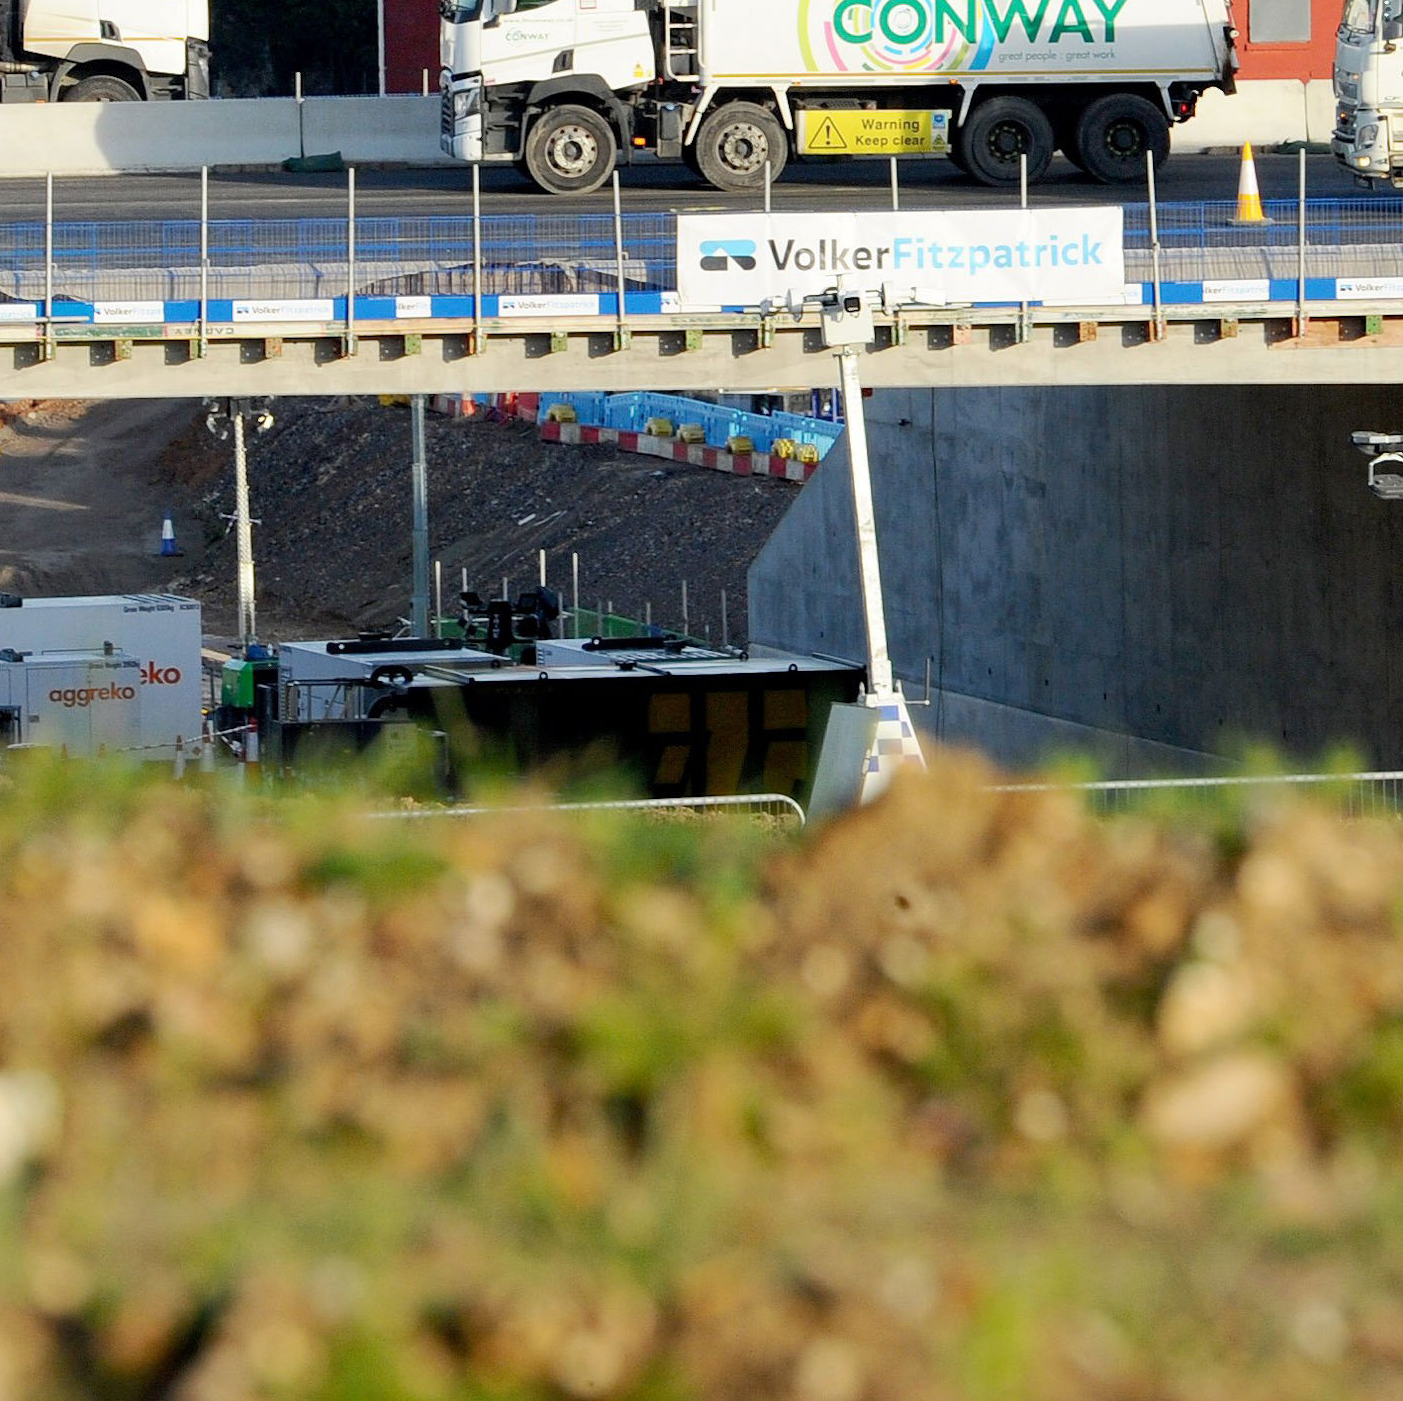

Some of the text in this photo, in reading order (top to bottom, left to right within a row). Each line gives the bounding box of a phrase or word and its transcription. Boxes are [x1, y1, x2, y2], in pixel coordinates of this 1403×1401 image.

[505, 32, 549, 42] CONWAY
[998, 52, 1023, 63] great
[1026, 49, 1057, 63] people
[1066, 51, 1091, 62] great
[1092, 48, 1115, 59] work
[861, 118, 920, 133] Warning
[855, 134, 925, 148] Keep clear
[768, 233, 1103, 276] VolkerFitzpatrick
[49, 682, 135, 707] aggreko
